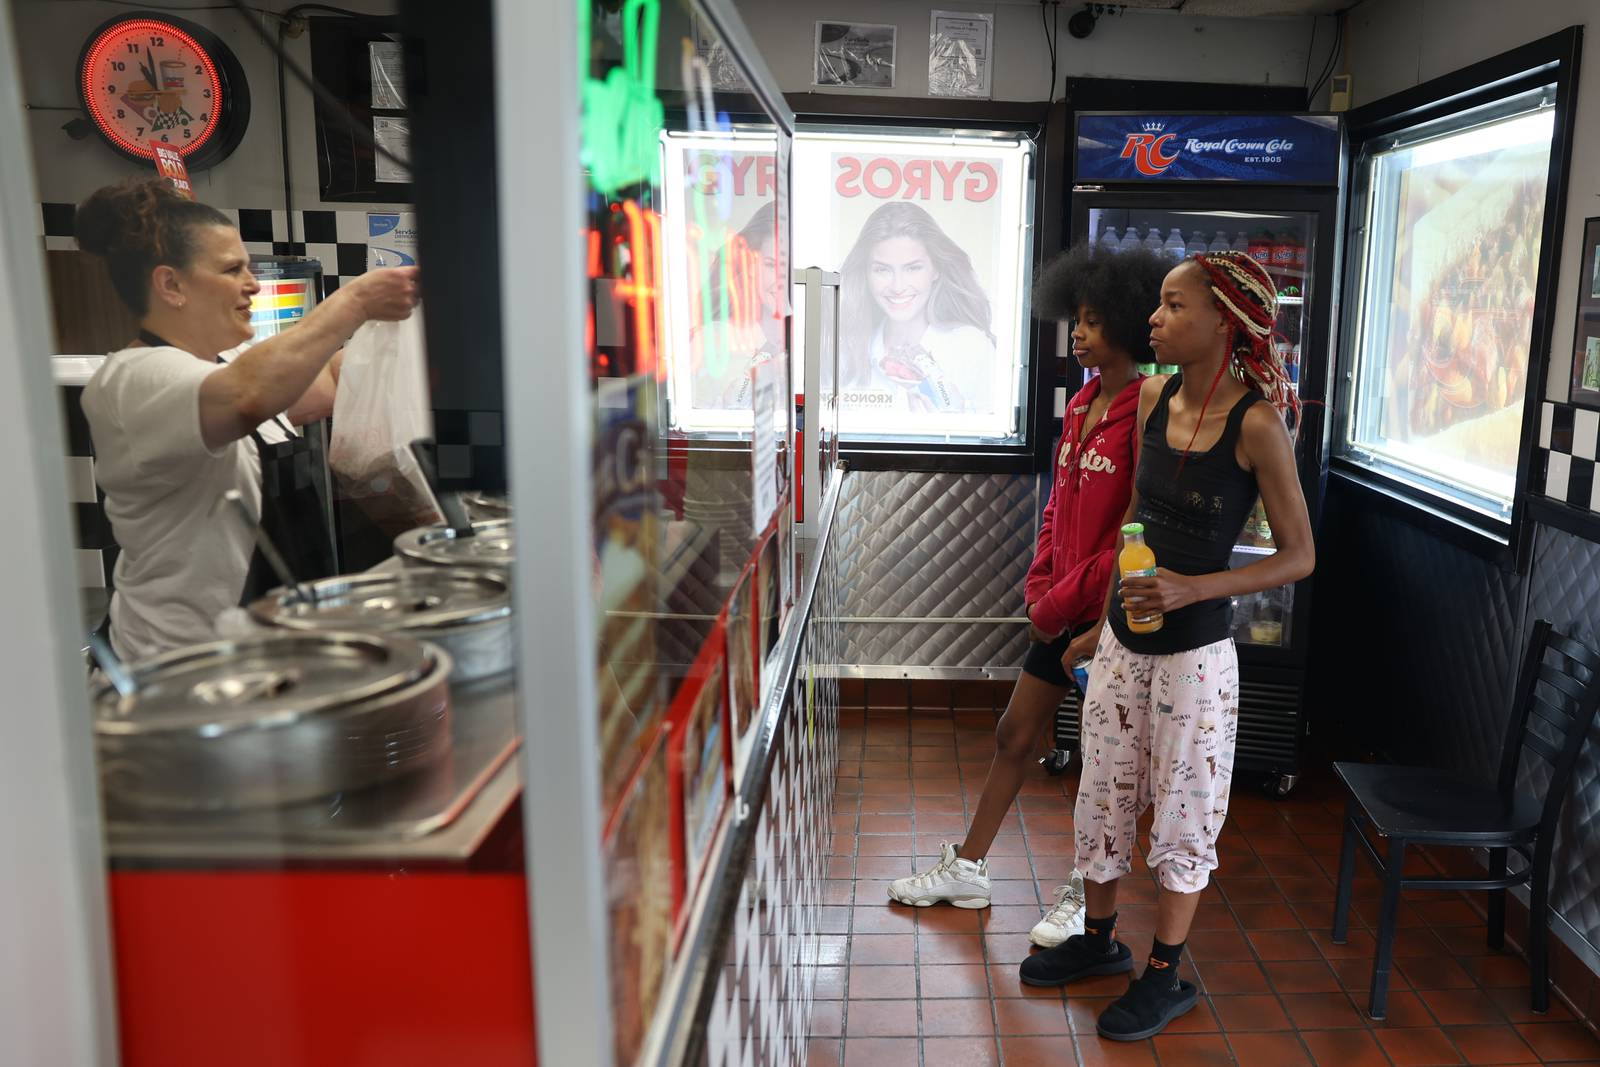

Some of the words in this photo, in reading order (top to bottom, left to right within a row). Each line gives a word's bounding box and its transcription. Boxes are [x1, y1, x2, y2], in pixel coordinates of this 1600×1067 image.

[150, 37, 164, 47] 12
[127, 44, 139, 53] 11
[111, 62, 125, 71] 10
[194, 65, 203, 75] 2
[107, 84, 116, 94] 9
[203, 89, 211, 98] 3
[117, 109, 126, 119] 8
[200, 113, 208, 122] 4
[136, 127, 144, 137] 7
[183, 129, 192, 138] 5
[160, 134, 169, 142] 6
[1119, 133, 1180, 175] RC
[1184, 138, 1224, 153] Royal
[1224, 138, 1265, 153] Crown
[1265, 139, 1293, 153] Cola
